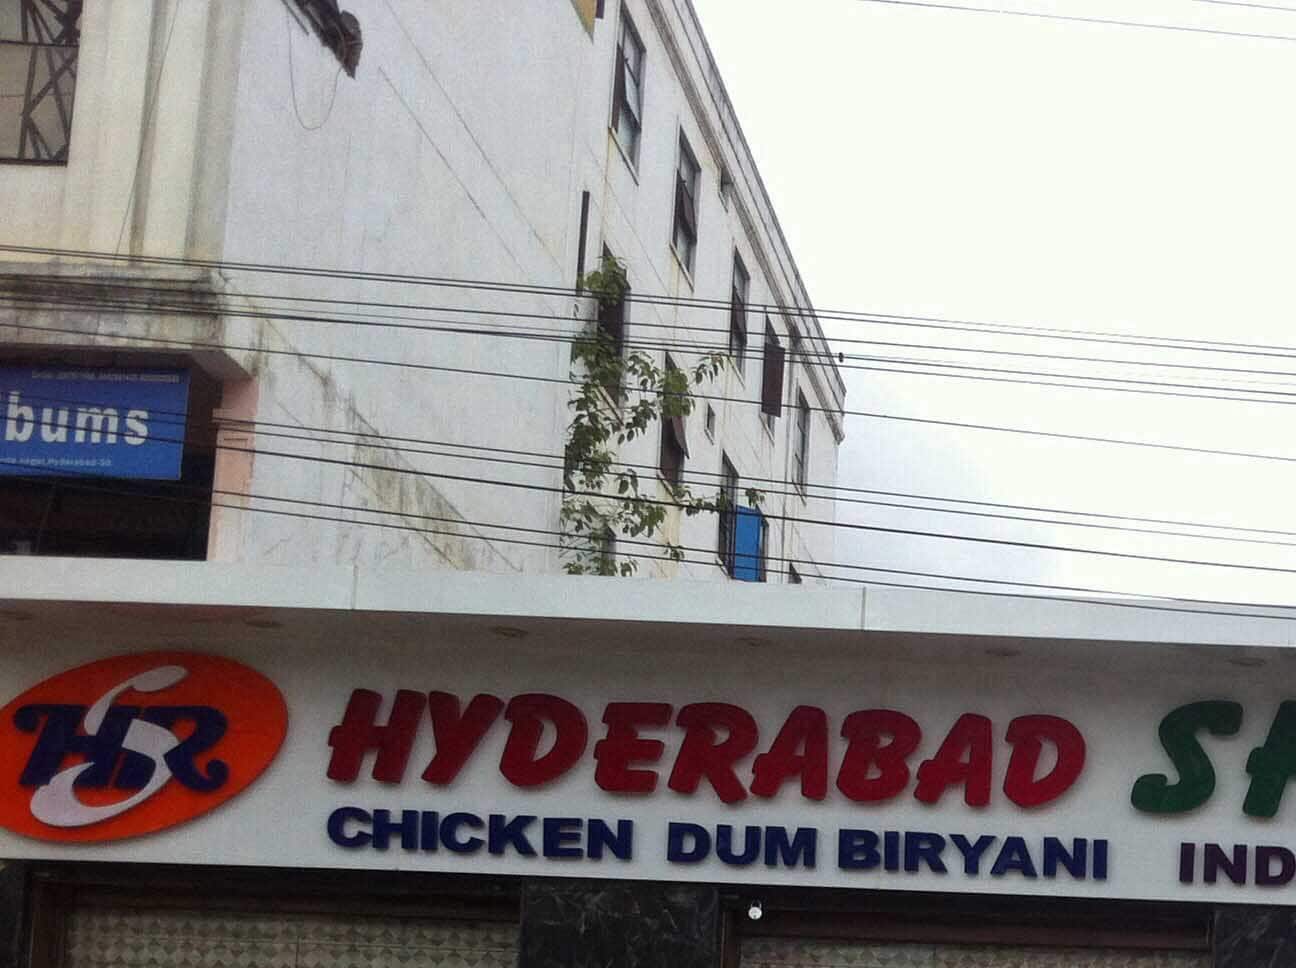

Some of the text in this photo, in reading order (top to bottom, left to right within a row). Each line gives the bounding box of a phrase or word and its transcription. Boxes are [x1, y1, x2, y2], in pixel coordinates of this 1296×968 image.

[326, 689, 1086, 808] HYDERABAD
[326, 807, 1109, 880] CHICKEN DUM BIRYANI
